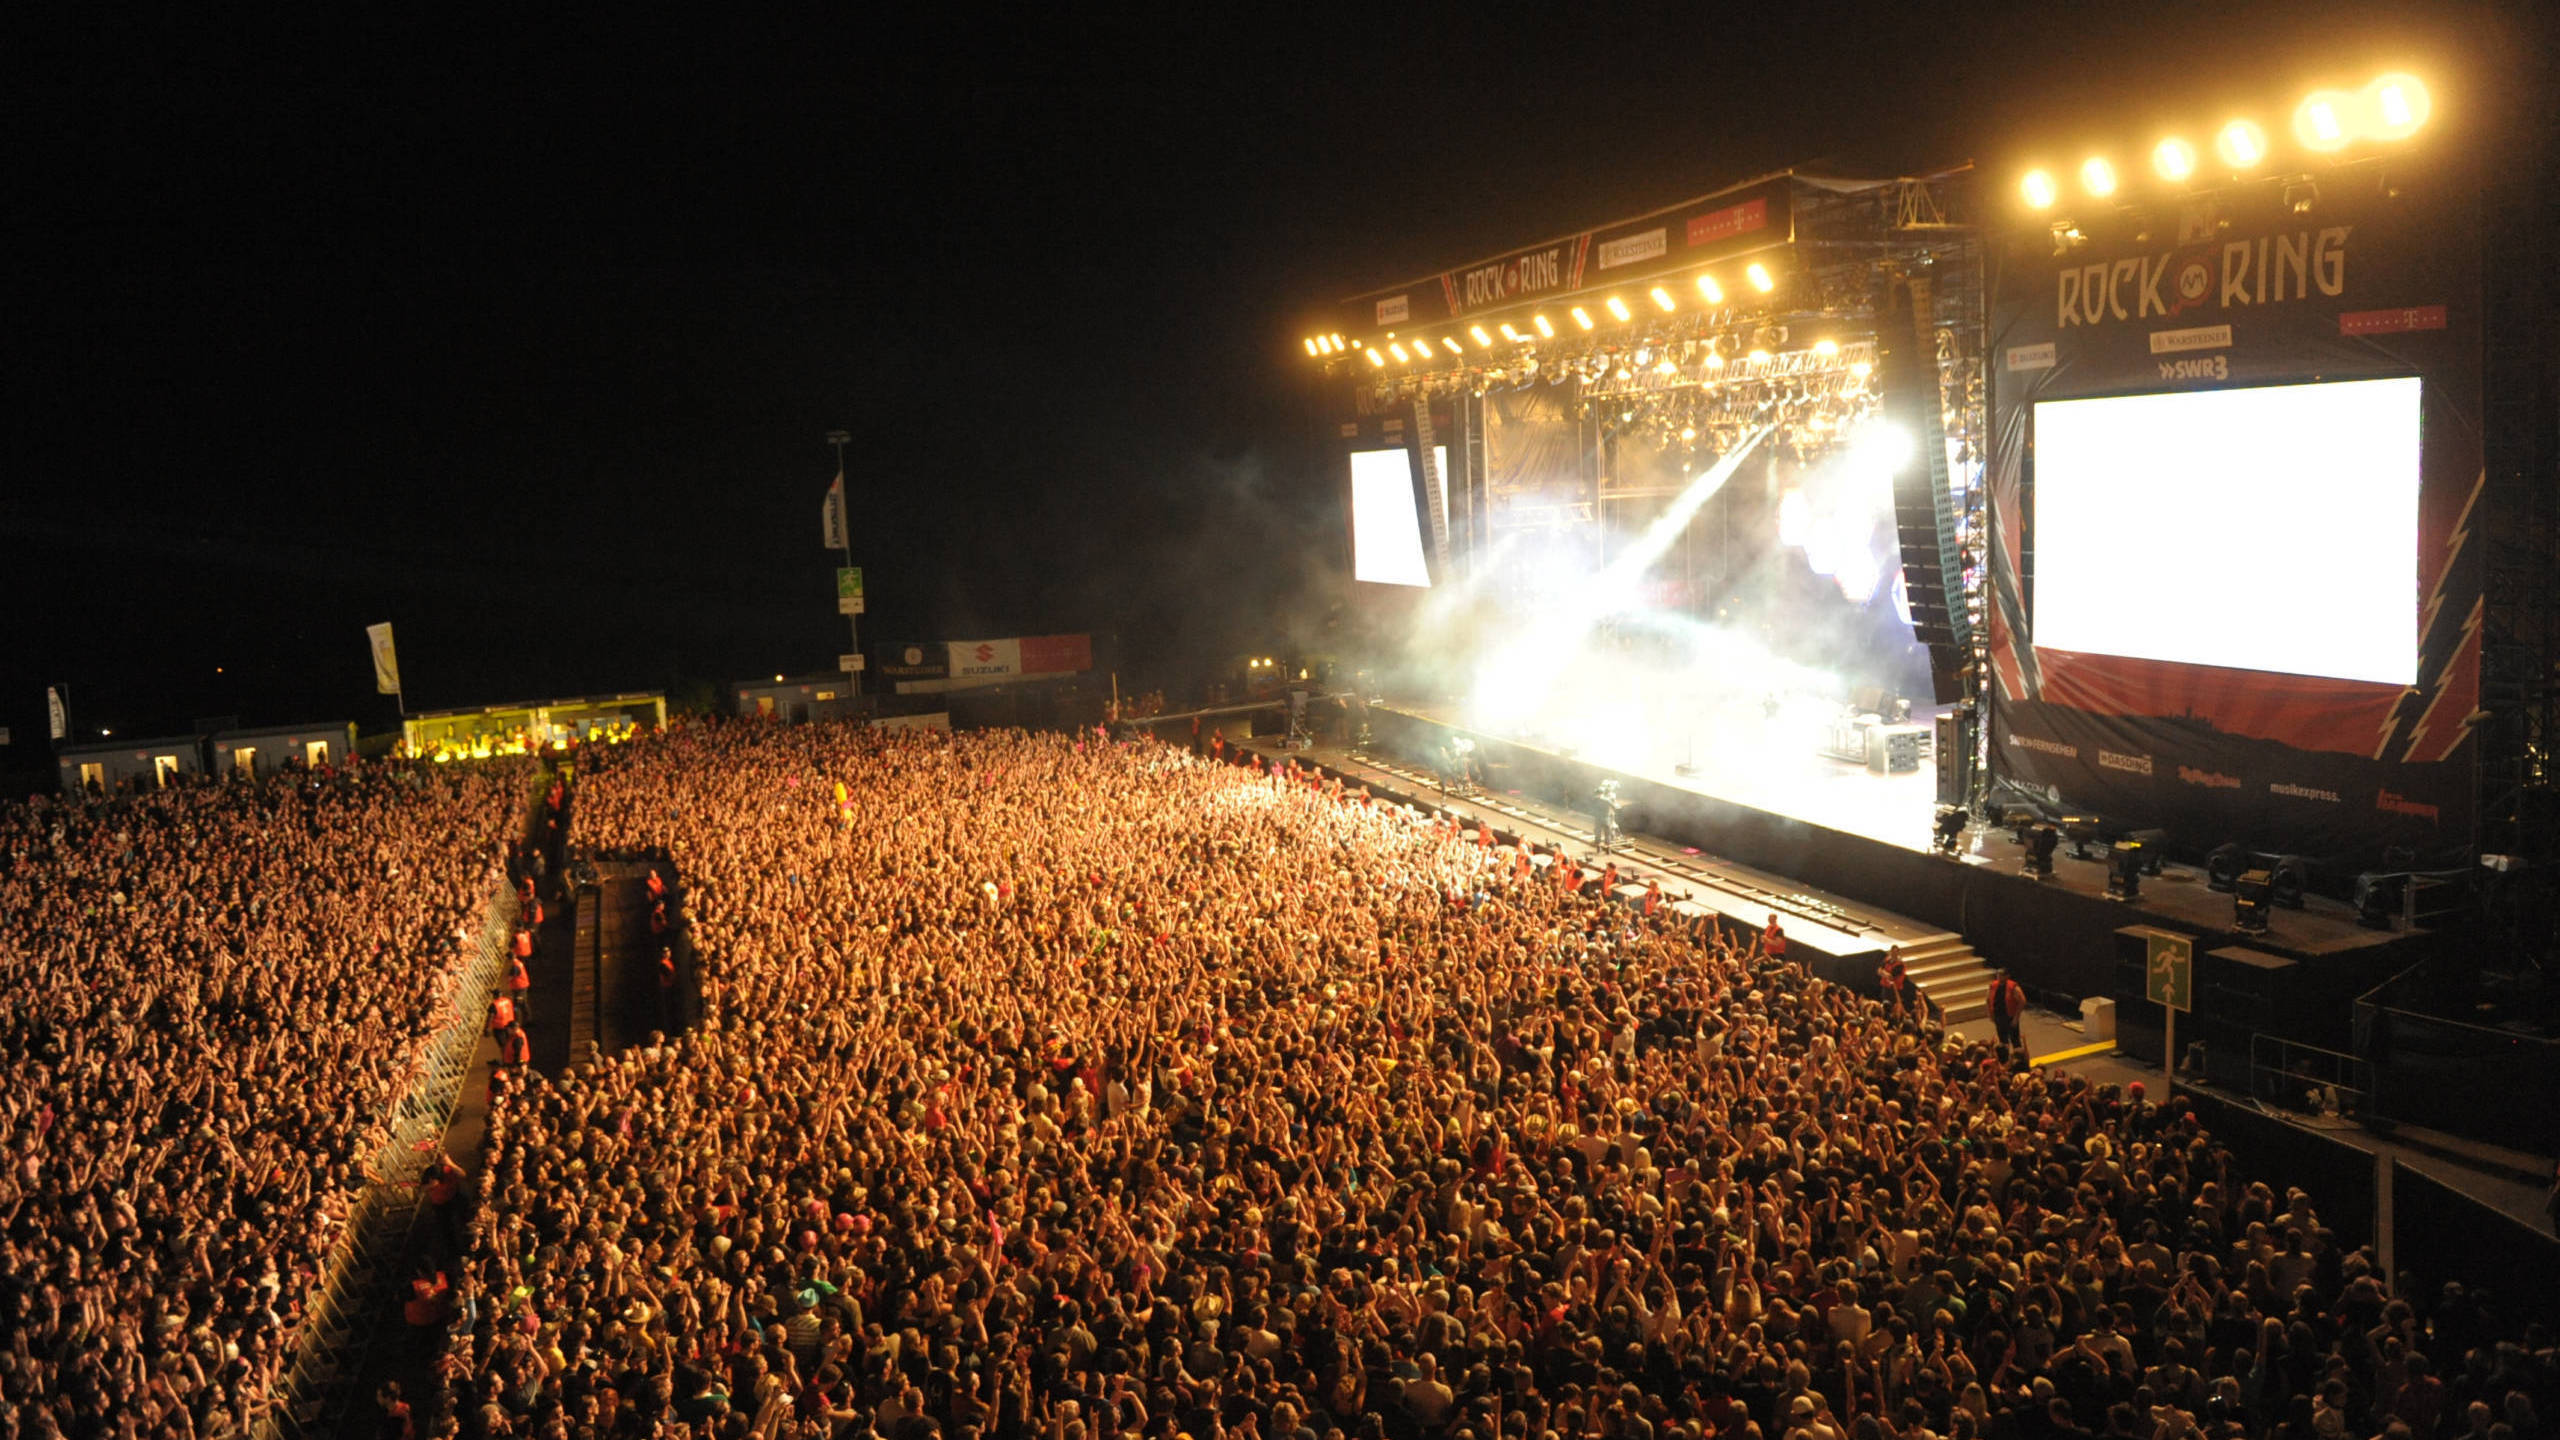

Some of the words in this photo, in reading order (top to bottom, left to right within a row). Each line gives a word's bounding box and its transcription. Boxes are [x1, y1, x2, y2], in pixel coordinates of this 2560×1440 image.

[1466, 263, 1506, 308] ROCK
[1520, 248, 1560, 294] RING
[2058, 252, 2172, 329] ROCK
[2220, 226, 2353, 308] RING
[2166, 331, 2228, 345] WARSTEINER
[961, 664, 1010, 674] SUZUKI
